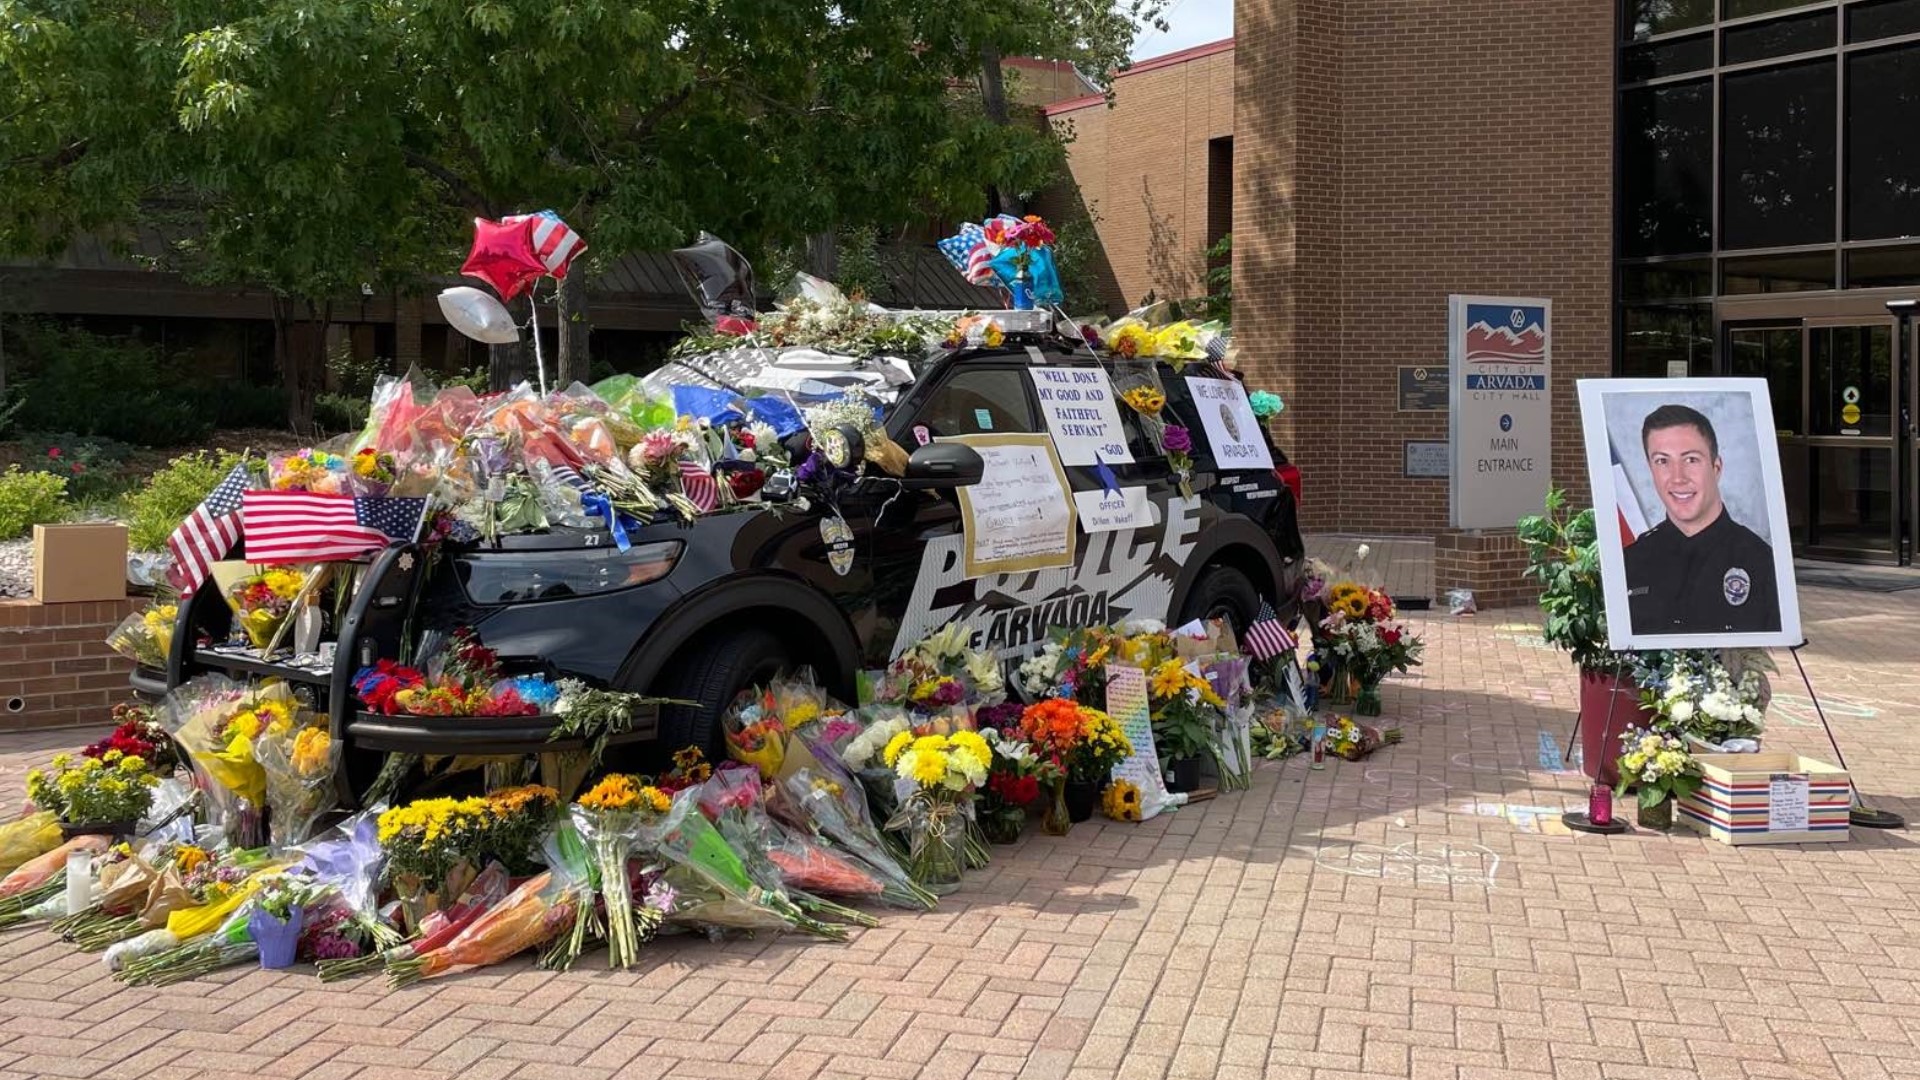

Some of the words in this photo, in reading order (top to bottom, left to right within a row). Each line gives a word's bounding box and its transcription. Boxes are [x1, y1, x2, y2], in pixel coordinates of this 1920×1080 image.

[1478, 365, 1509, 374] CITY
[1519, 366, 1534, 374] OF
[1072, 372, 1099, 384] DONE
[1476, 375, 1536, 389] ARVADA
[1038, 388, 1054, 401] MY
[1056, 389, 1081, 401] GOOD
[1085, 389, 1104, 401] AND
[1473, 392, 1504, 400] CITY
[1512, 392, 1540, 400] HALL
[1054, 407, 1102, 420] FAITHFUL
[1490, 438, 1519, 451] MAIN
[1478, 458, 1533, 472] ENTRANCE
[1098, 500, 1125, 510] OFFICER
[584, 534, 600, 546] 27
[986, 590, 1108, 650] ARVADA
